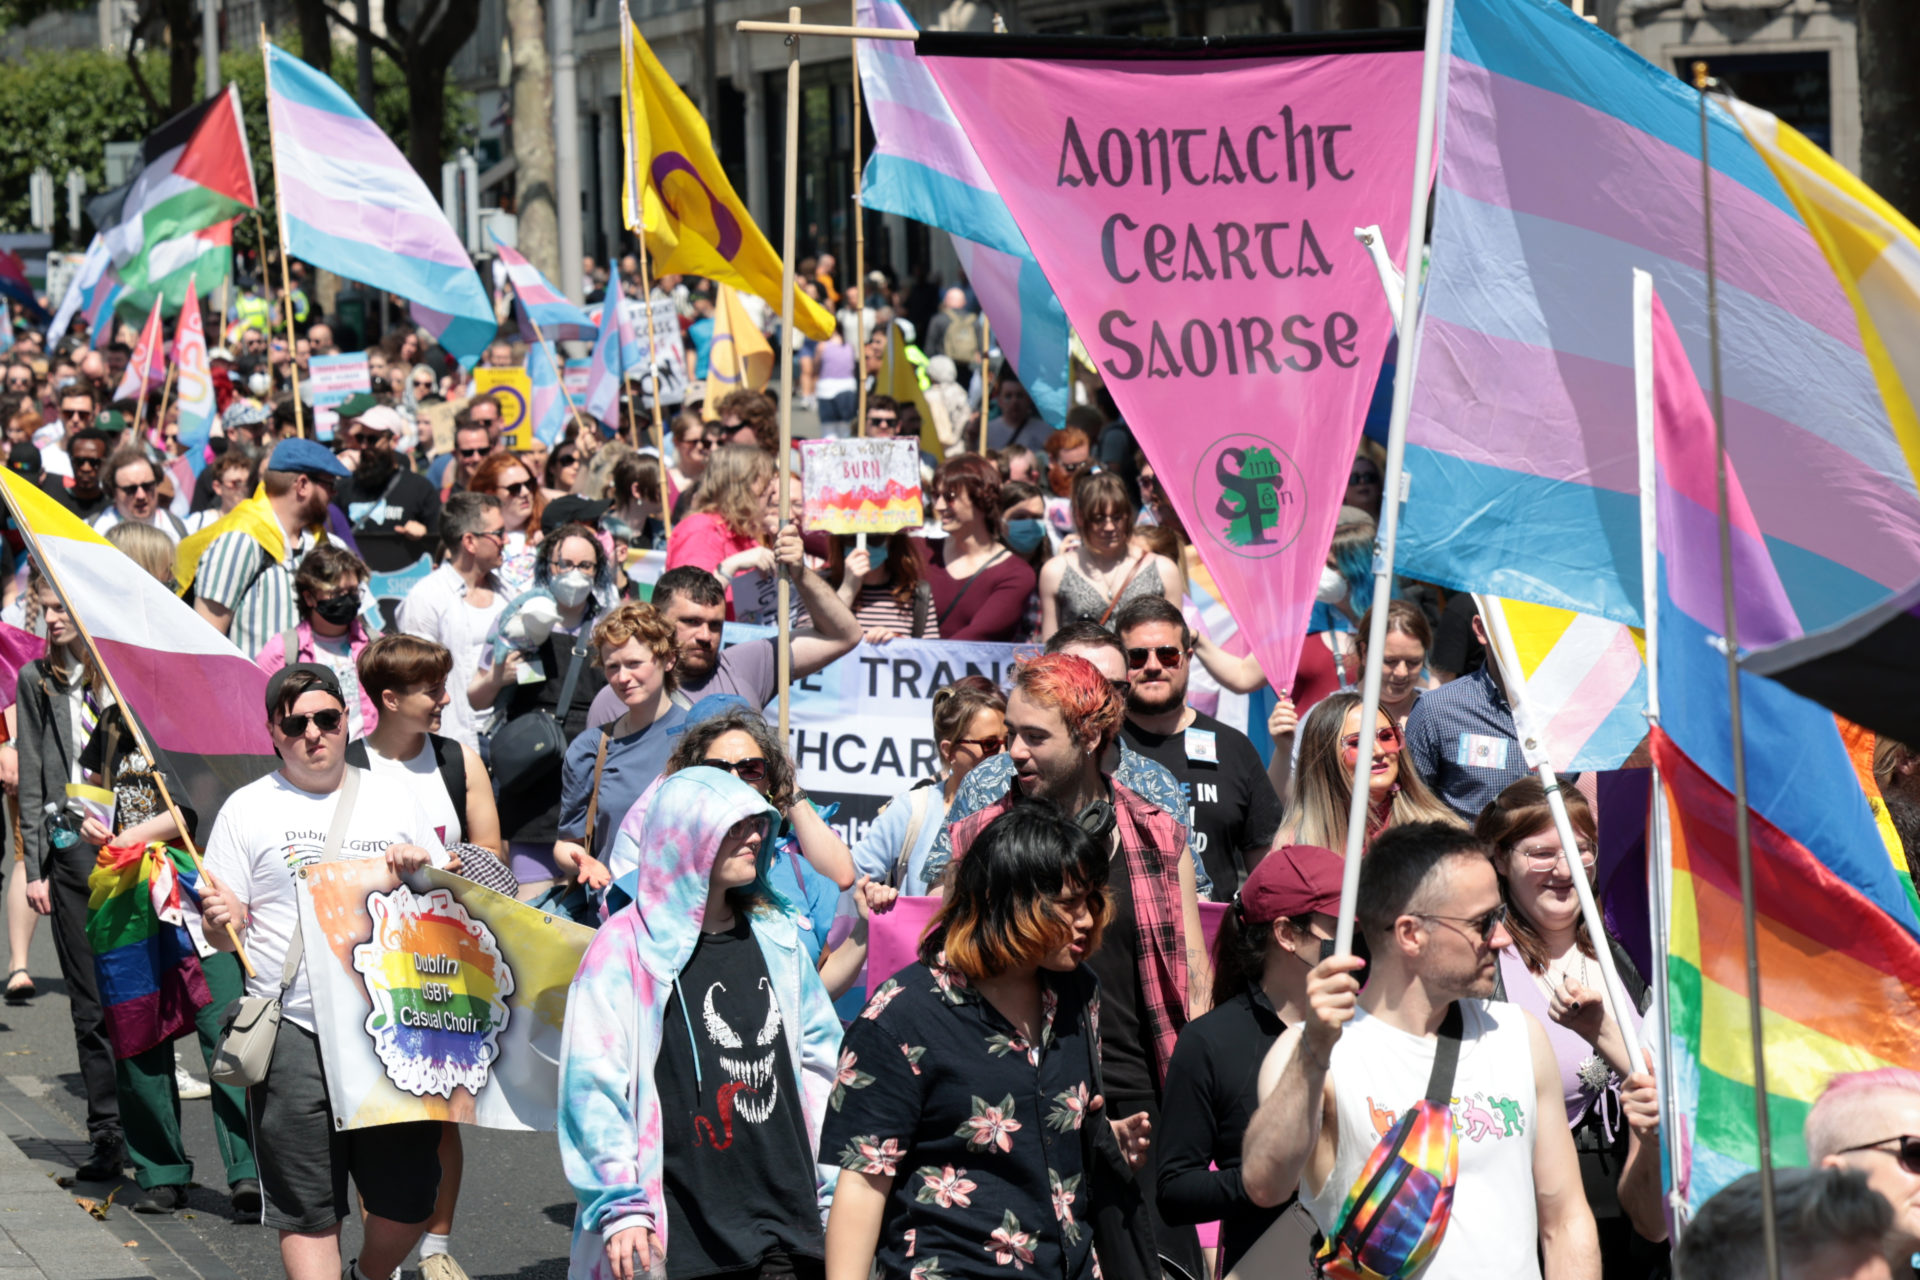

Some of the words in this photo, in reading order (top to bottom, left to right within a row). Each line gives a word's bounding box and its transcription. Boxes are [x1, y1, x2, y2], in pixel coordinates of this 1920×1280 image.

[843, 460, 882, 479] BURN
[1196, 783, 1219, 804] IN
[285, 830, 326, 842] Dubli
[414, 951, 458, 975] Dublin
[421, 981, 454, 1002] LGBT+
[400, 1005, 442, 1030] Casual
[443, 1011, 482, 1033] Choir
